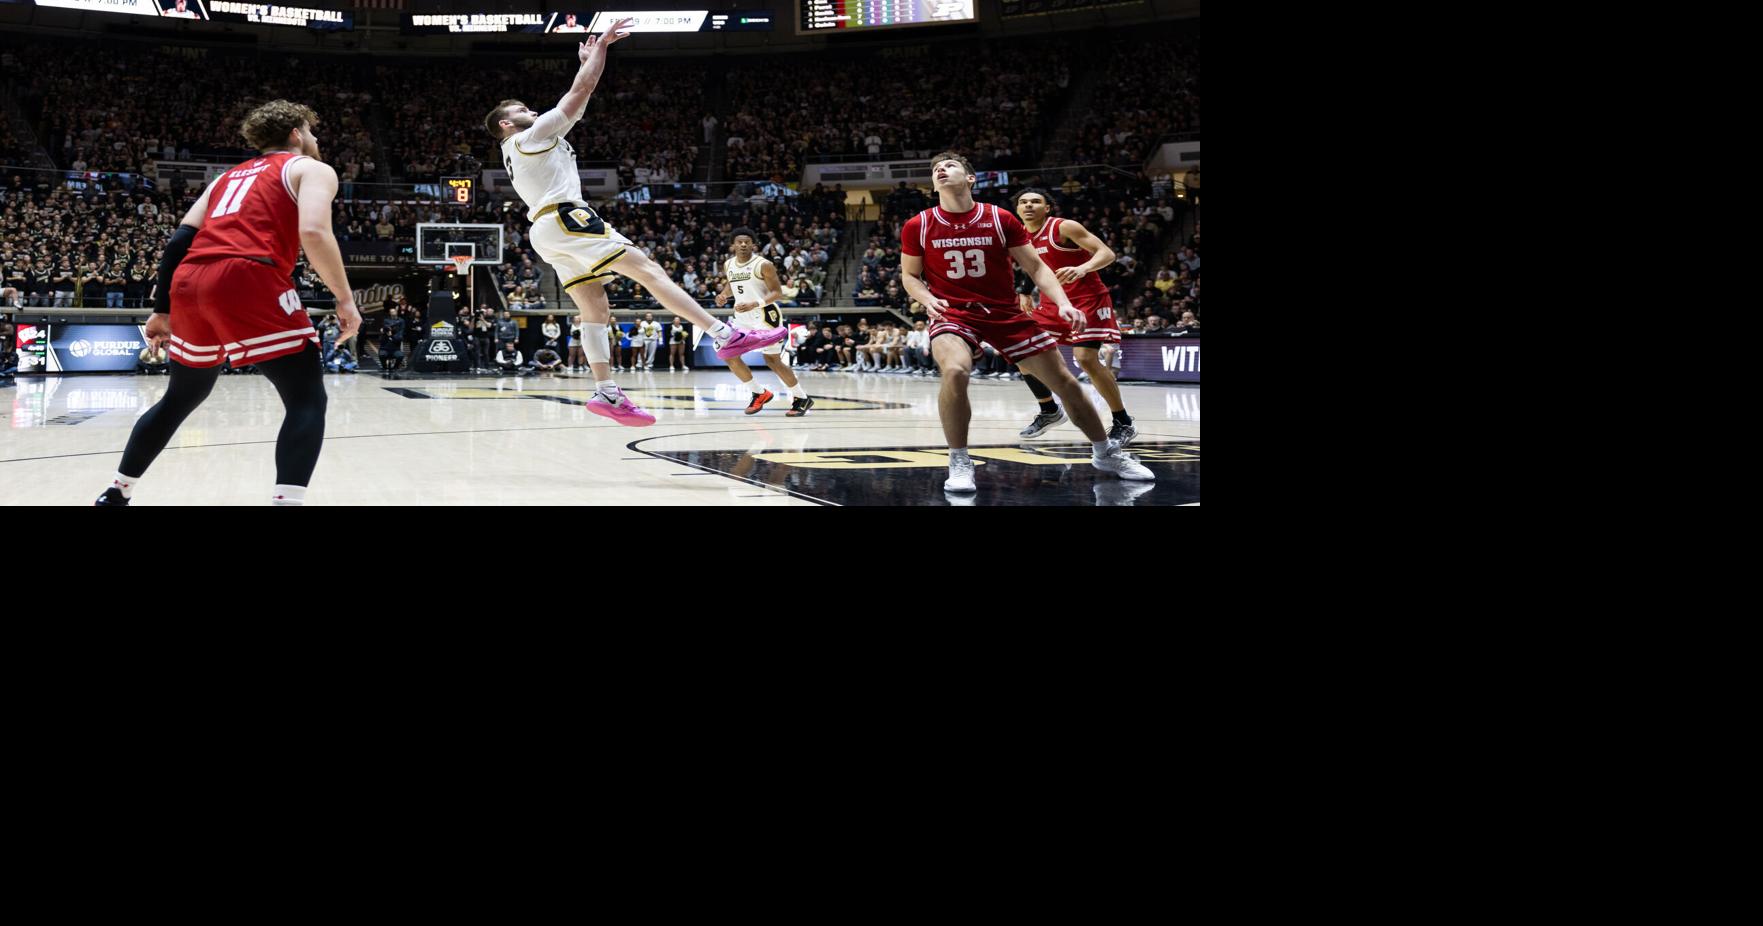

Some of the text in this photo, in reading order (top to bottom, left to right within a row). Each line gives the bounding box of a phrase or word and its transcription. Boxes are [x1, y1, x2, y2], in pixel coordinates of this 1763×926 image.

[209, 0, 344, 22] WOMEN'S BASKETBALL
[412, 14, 544, 26] WOMEN'S BASKETBALL
[449, 180, 471, 188] 4:47
[210, 174, 258, 219] 11
[457, 187, 469, 202] 8
[568, 208, 591, 228] P
[931, 236, 993, 249] WISCONSIN
[349, 254, 377, 263] TIME
[381, 255, 394, 263] TO
[943, 248, 987, 280] 33
[737, 285, 744, 295] 5
[278, 288, 302, 316] W
[1096, 306, 1112, 321] W
[93, 341, 140, 349] PURDUE
[1161, 346, 1200, 372] WIT
